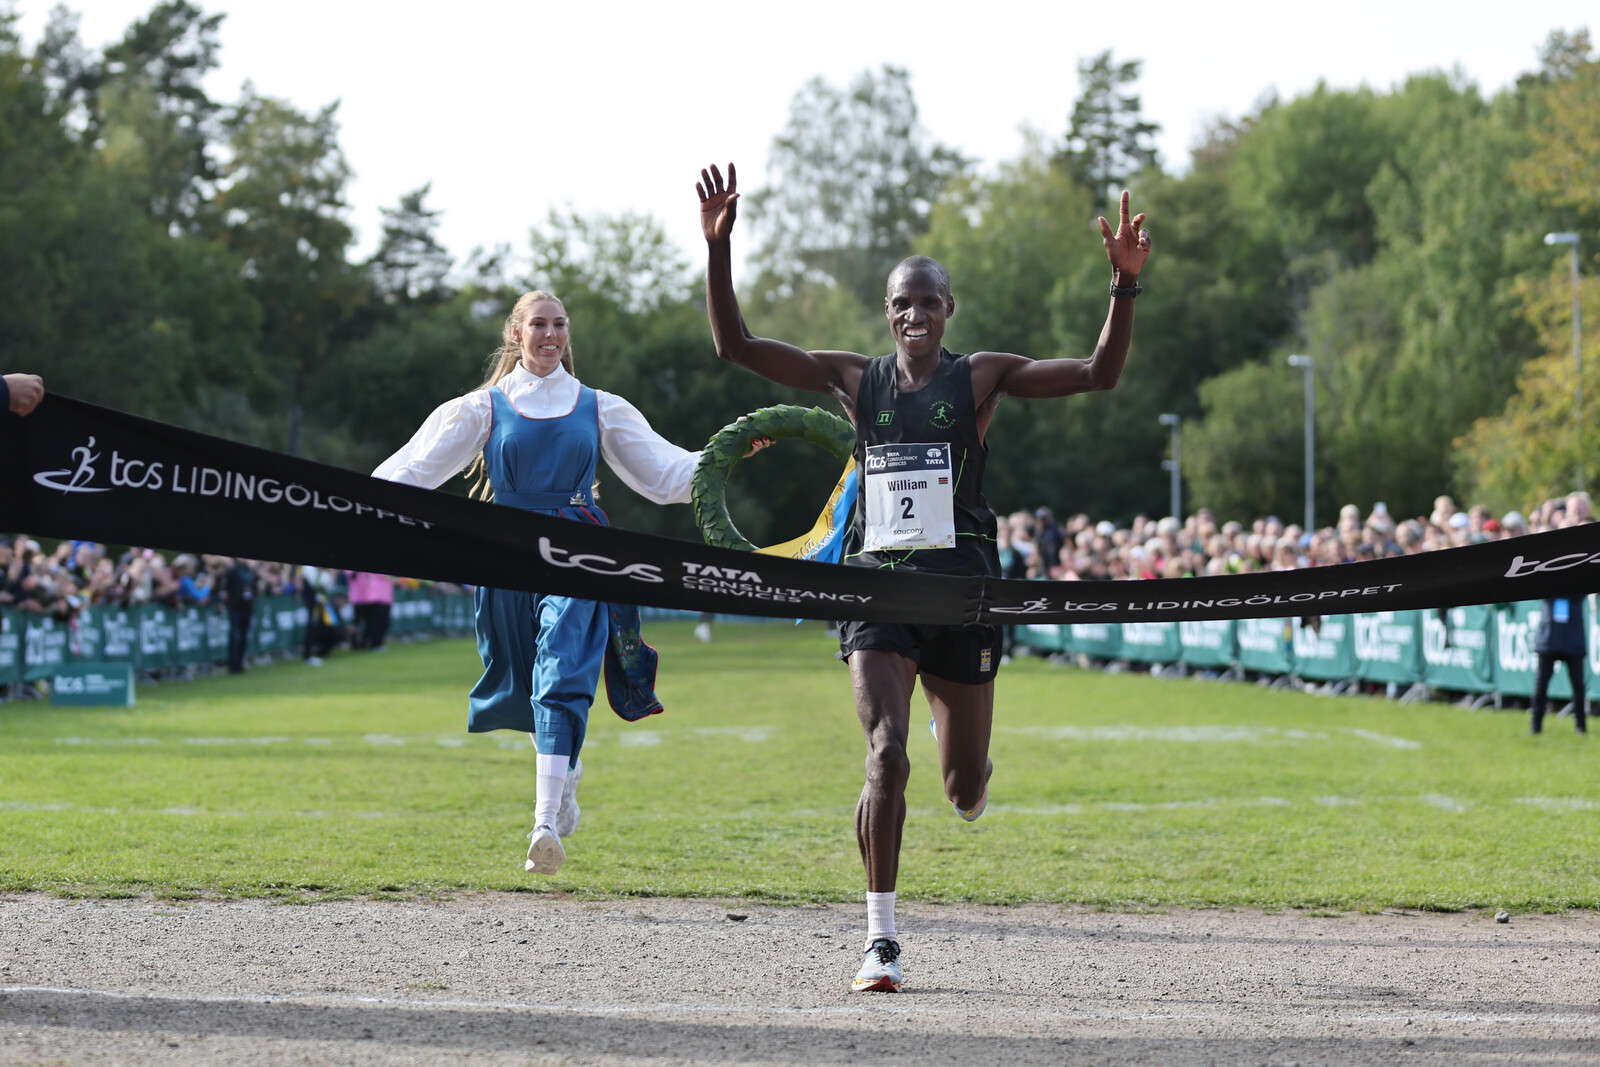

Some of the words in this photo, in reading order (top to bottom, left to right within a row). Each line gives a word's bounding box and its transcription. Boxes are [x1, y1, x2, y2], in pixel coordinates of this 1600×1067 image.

[109, 450, 163, 491] tcs
[172, 464, 436, 529] LIDINGÖLOPPET
[887, 480, 927, 492] William
[900, 497, 915, 519] 2
[893, 528, 924, 537] saucony
[538, 537, 664, 582] tcs
[682, 562, 763, 583] TATA
[682, 576, 872, 604] CONSULTANCY
[684, 583, 801, 603] SERVICES
[1064, 600, 1118, 611] tcs
[1128, 584, 1402, 611] LIDINGÖLOPPET
